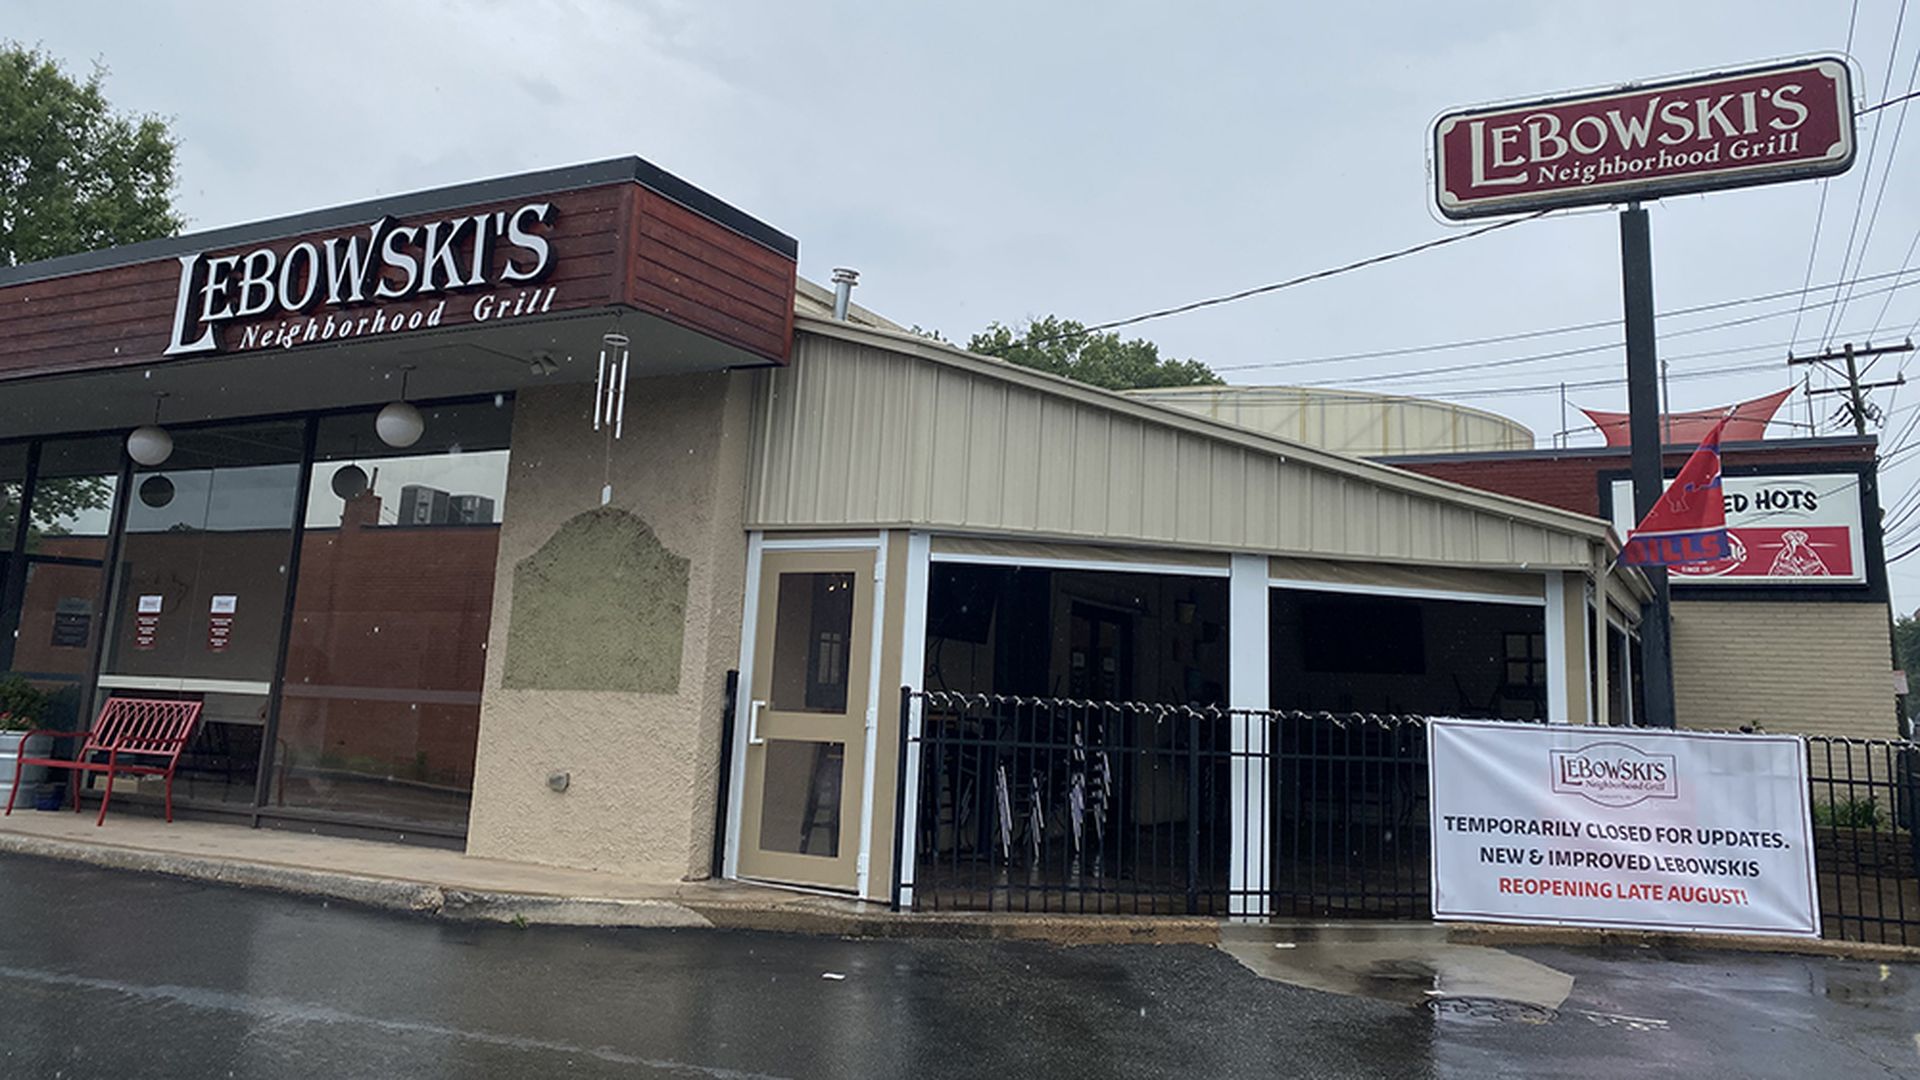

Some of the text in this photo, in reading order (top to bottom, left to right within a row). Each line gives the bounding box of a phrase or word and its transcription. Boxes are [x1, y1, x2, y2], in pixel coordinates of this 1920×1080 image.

[1468, 85, 1810, 188] LEBOWSKI'S
[1537, 131, 1800, 186] Neighborhood Grill
[163, 203, 556, 356] LEBOWSKI'S
[239, 287, 558, 350] Neighborhood Grill
[1723, 489, 1818, 514] ED HOTS
[1624, 535, 1719, 564] BILLS
[1443, 816, 1791, 849] TEMPORARILY CLOSED FOR UPDATES.
[1480, 847, 1760, 877] NEW & IMPROVED LEBOWSKIS
[1499, 877, 1749, 906] REOPENING LATE AUGUST!
